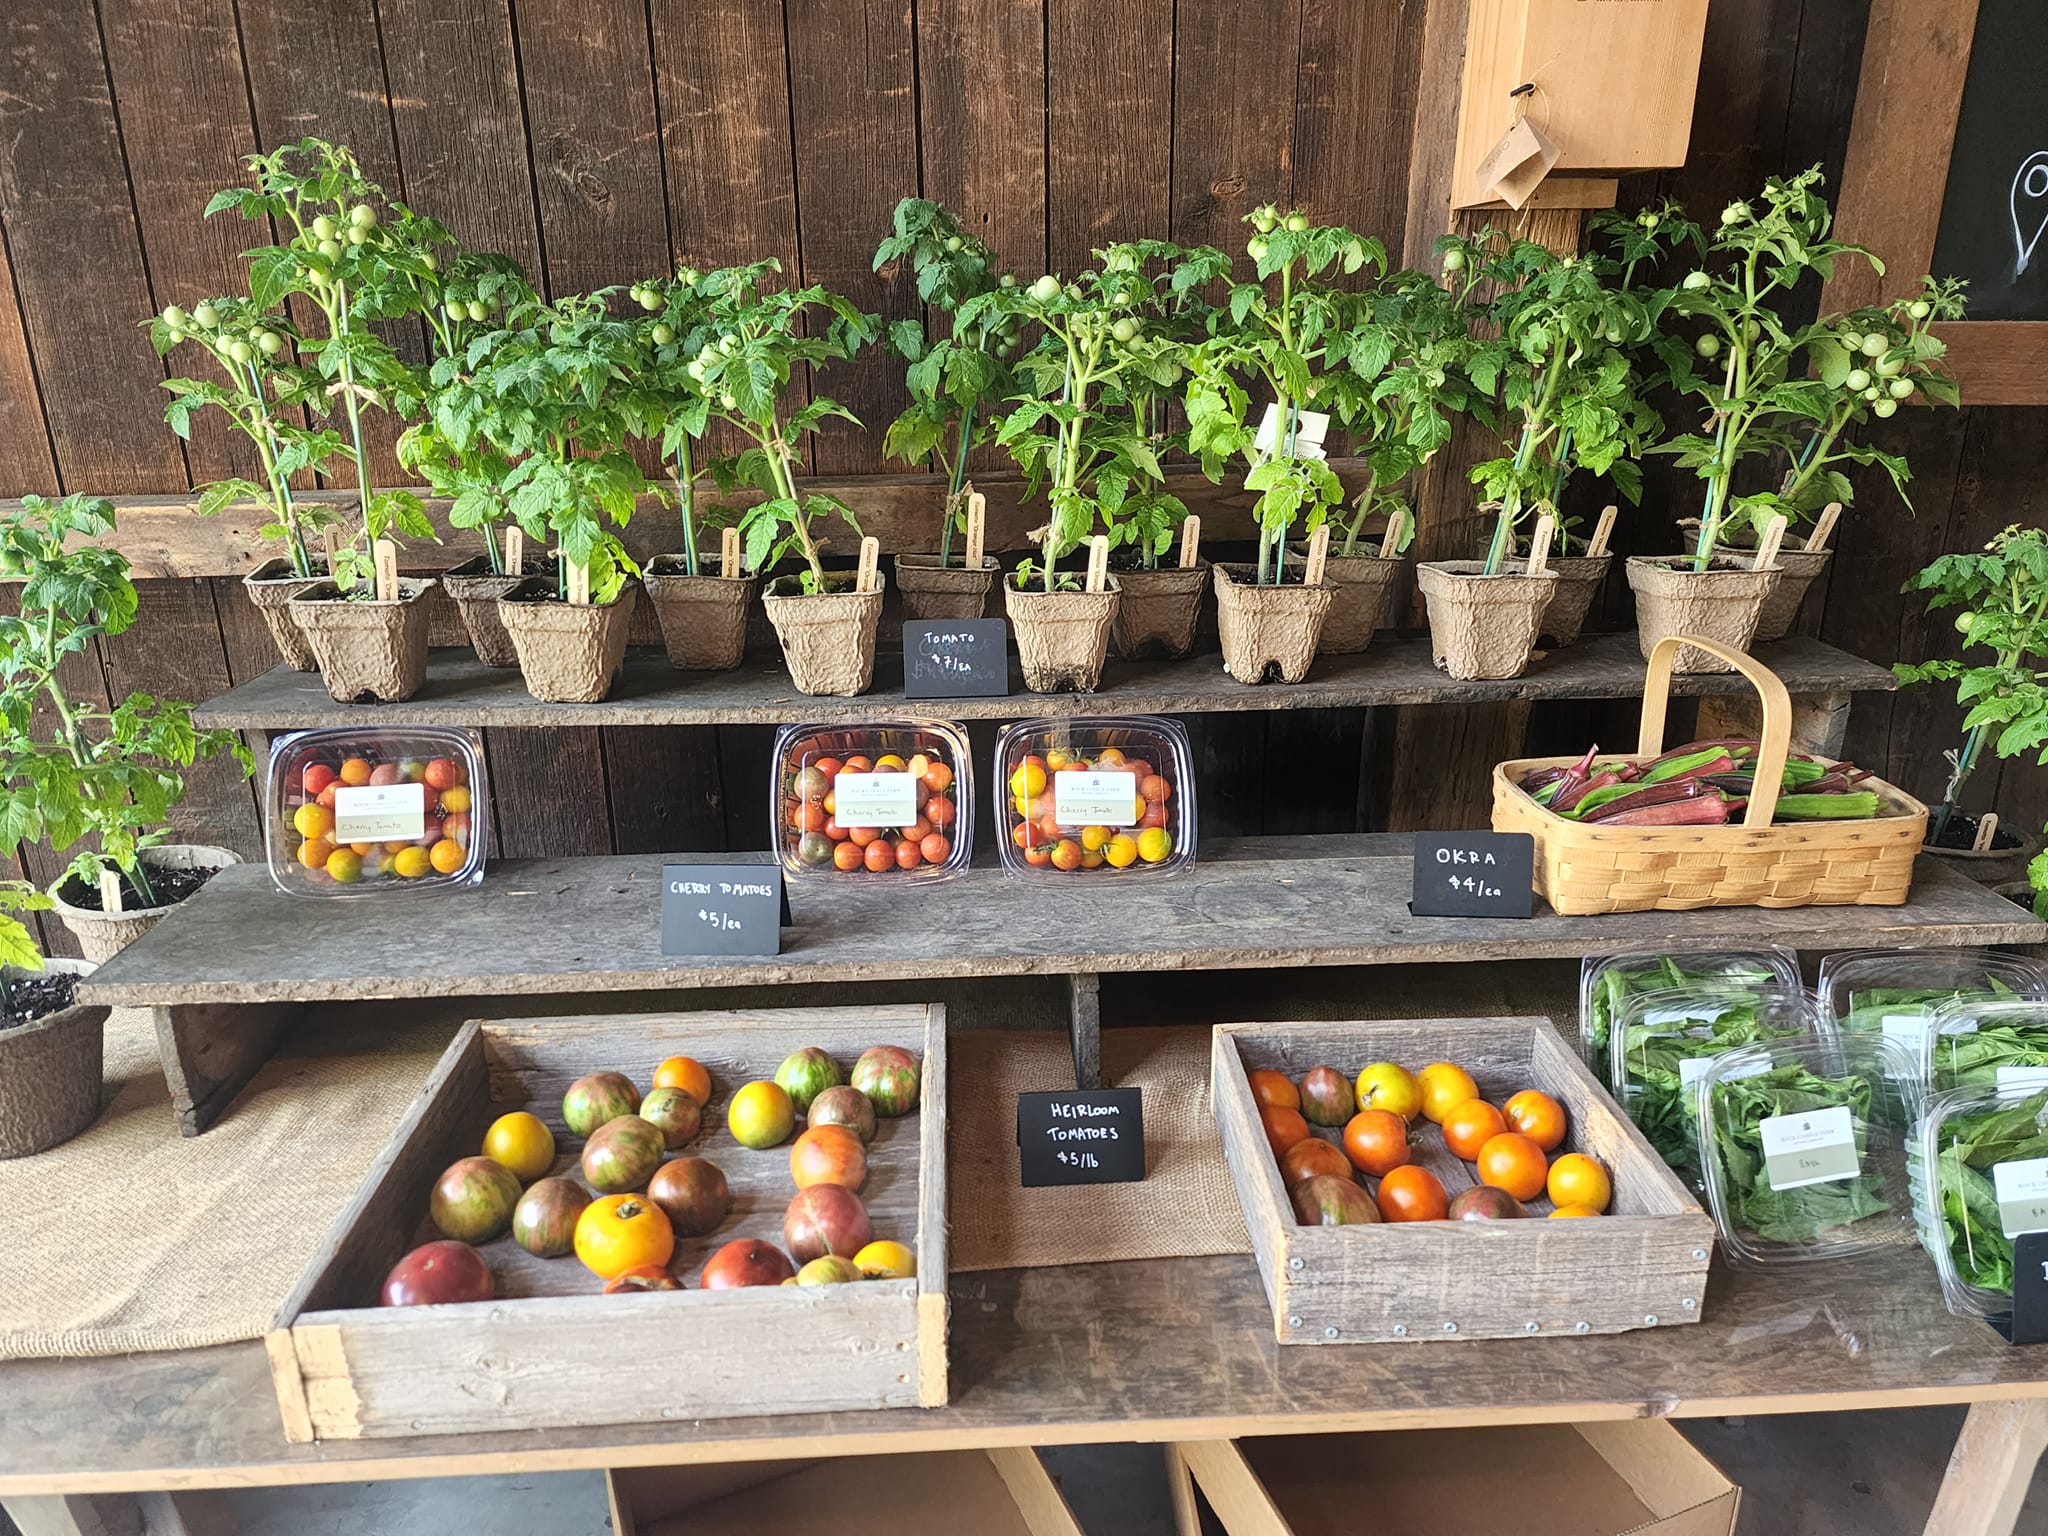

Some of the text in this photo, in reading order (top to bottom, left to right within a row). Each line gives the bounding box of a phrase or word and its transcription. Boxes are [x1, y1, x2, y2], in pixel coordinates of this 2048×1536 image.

[924, 631, 975, 644] TOMATO
[341, 822, 371, 833] Cherry
[1435, 848, 1496, 865] OKRA
[670, 881, 773, 897] CHERRY TOMATOES
[1448, 874, 1501, 897] $4/ea
[698, 908, 742, 931] $5/ea
[1050, 1103, 1120, 1119] HEIRLOOM
[1046, 1126, 1119, 1141] TOMATOES
[1056, 1150, 1099, 1169] $5/lb
